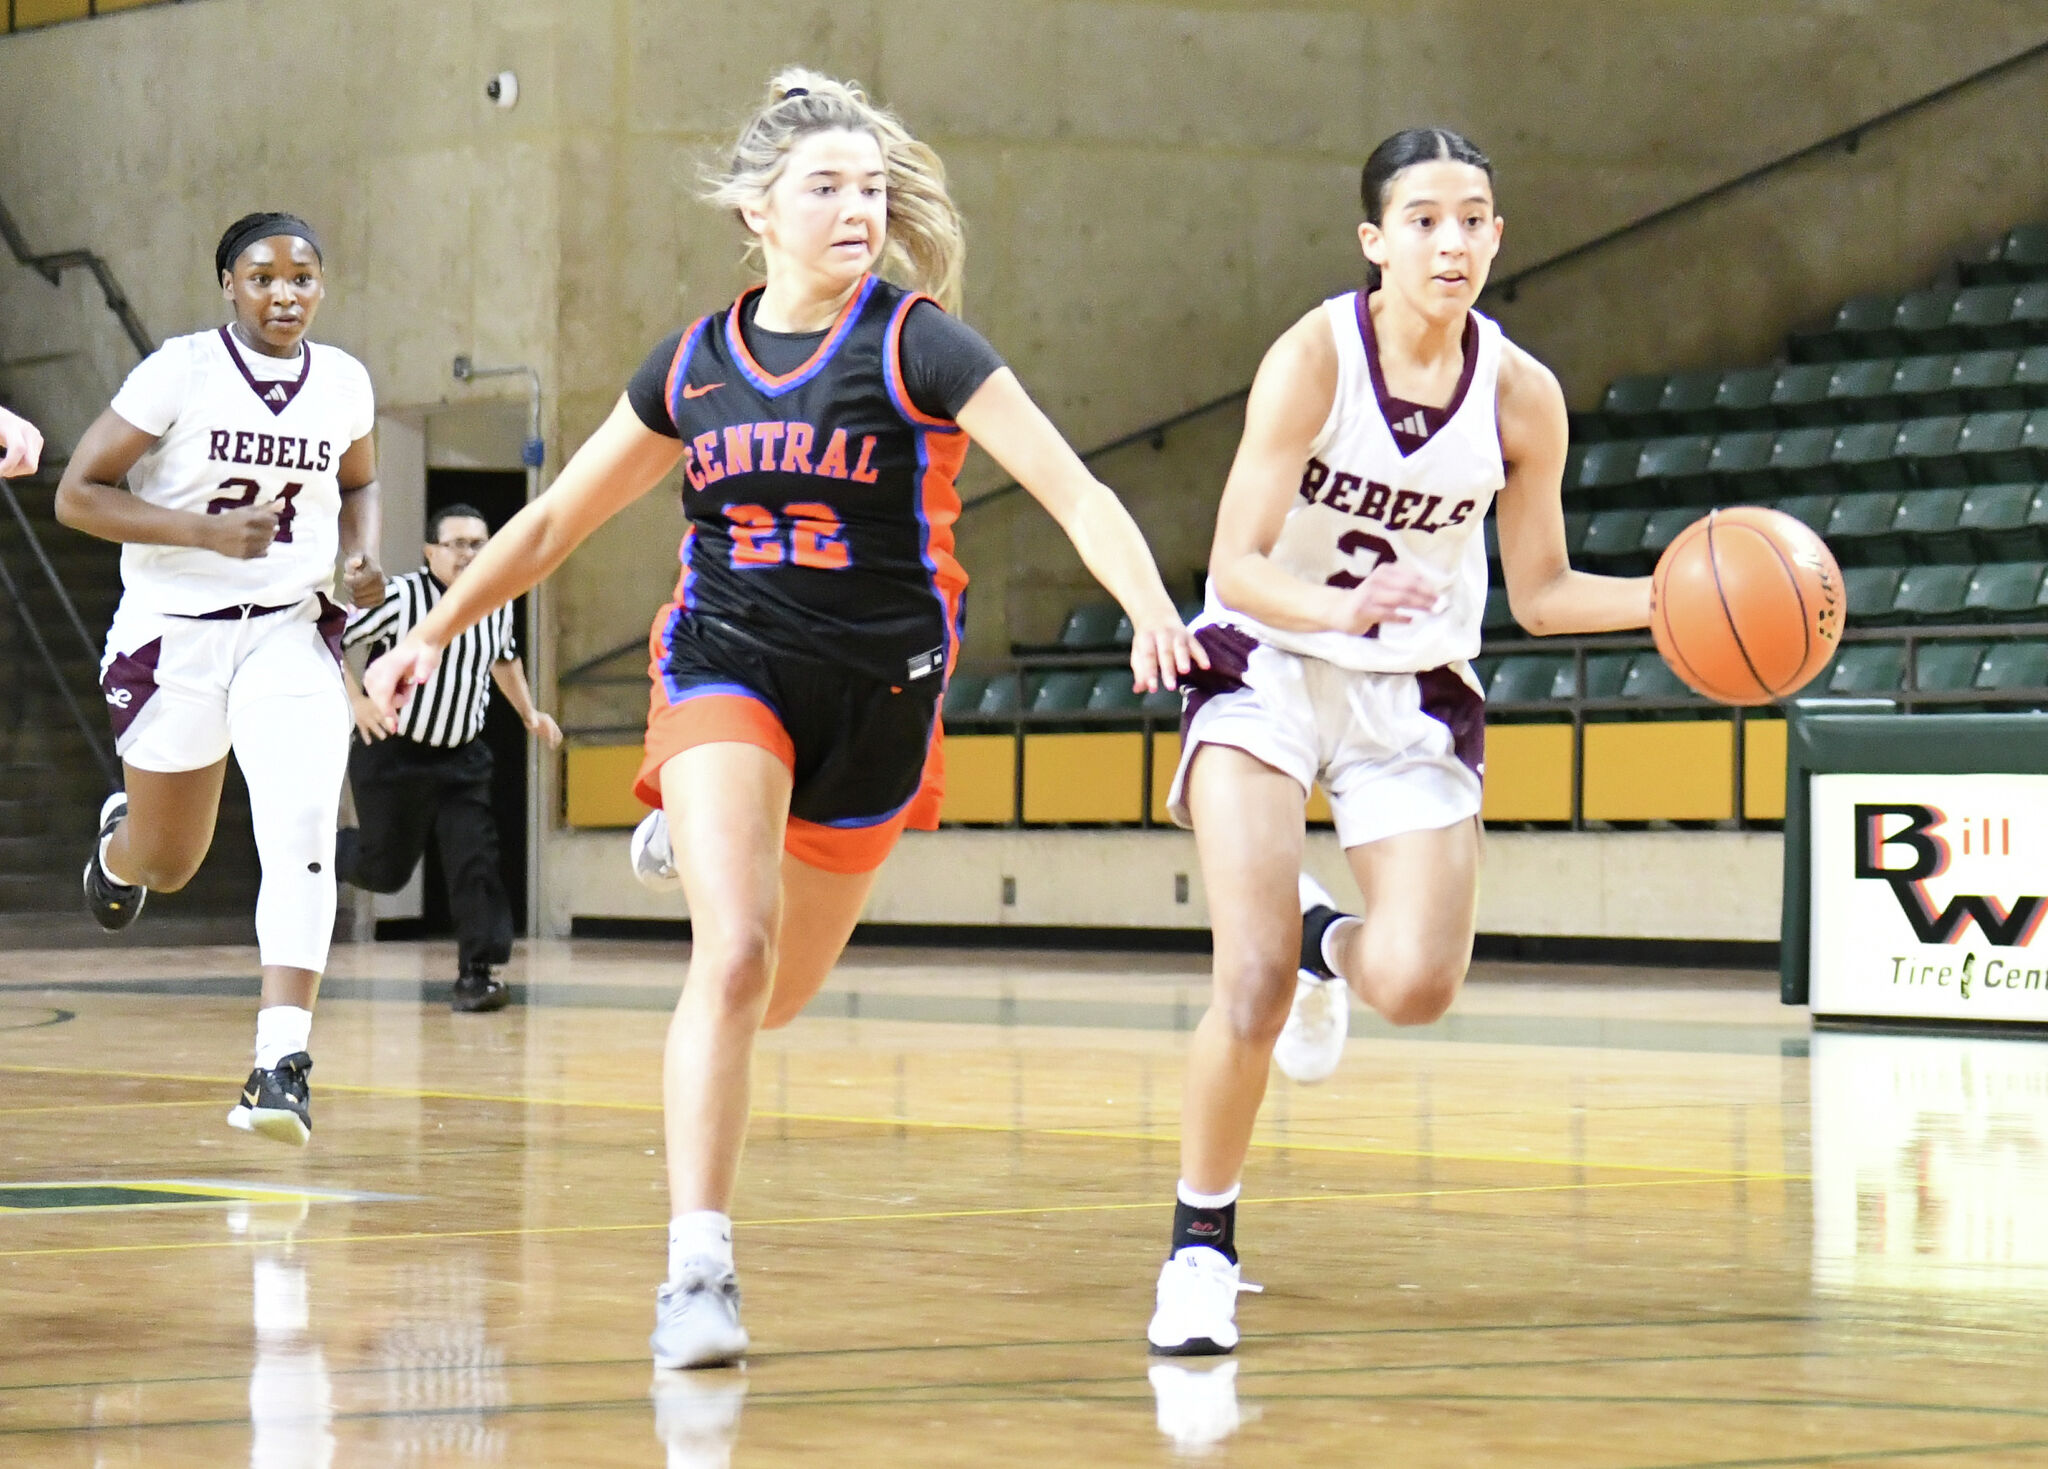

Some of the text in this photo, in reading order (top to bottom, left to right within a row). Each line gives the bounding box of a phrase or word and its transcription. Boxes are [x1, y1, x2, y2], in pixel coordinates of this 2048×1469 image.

[208, 429, 331, 472] REBELS
[684, 421, 880, 492] CENTRAL
[1299, 456, 1477, 535] REBELS
[722, 503, 854, 570] 22
[1855, 803, 2010, 881] Bill
[1891, 956, 1952, 986] Tire
